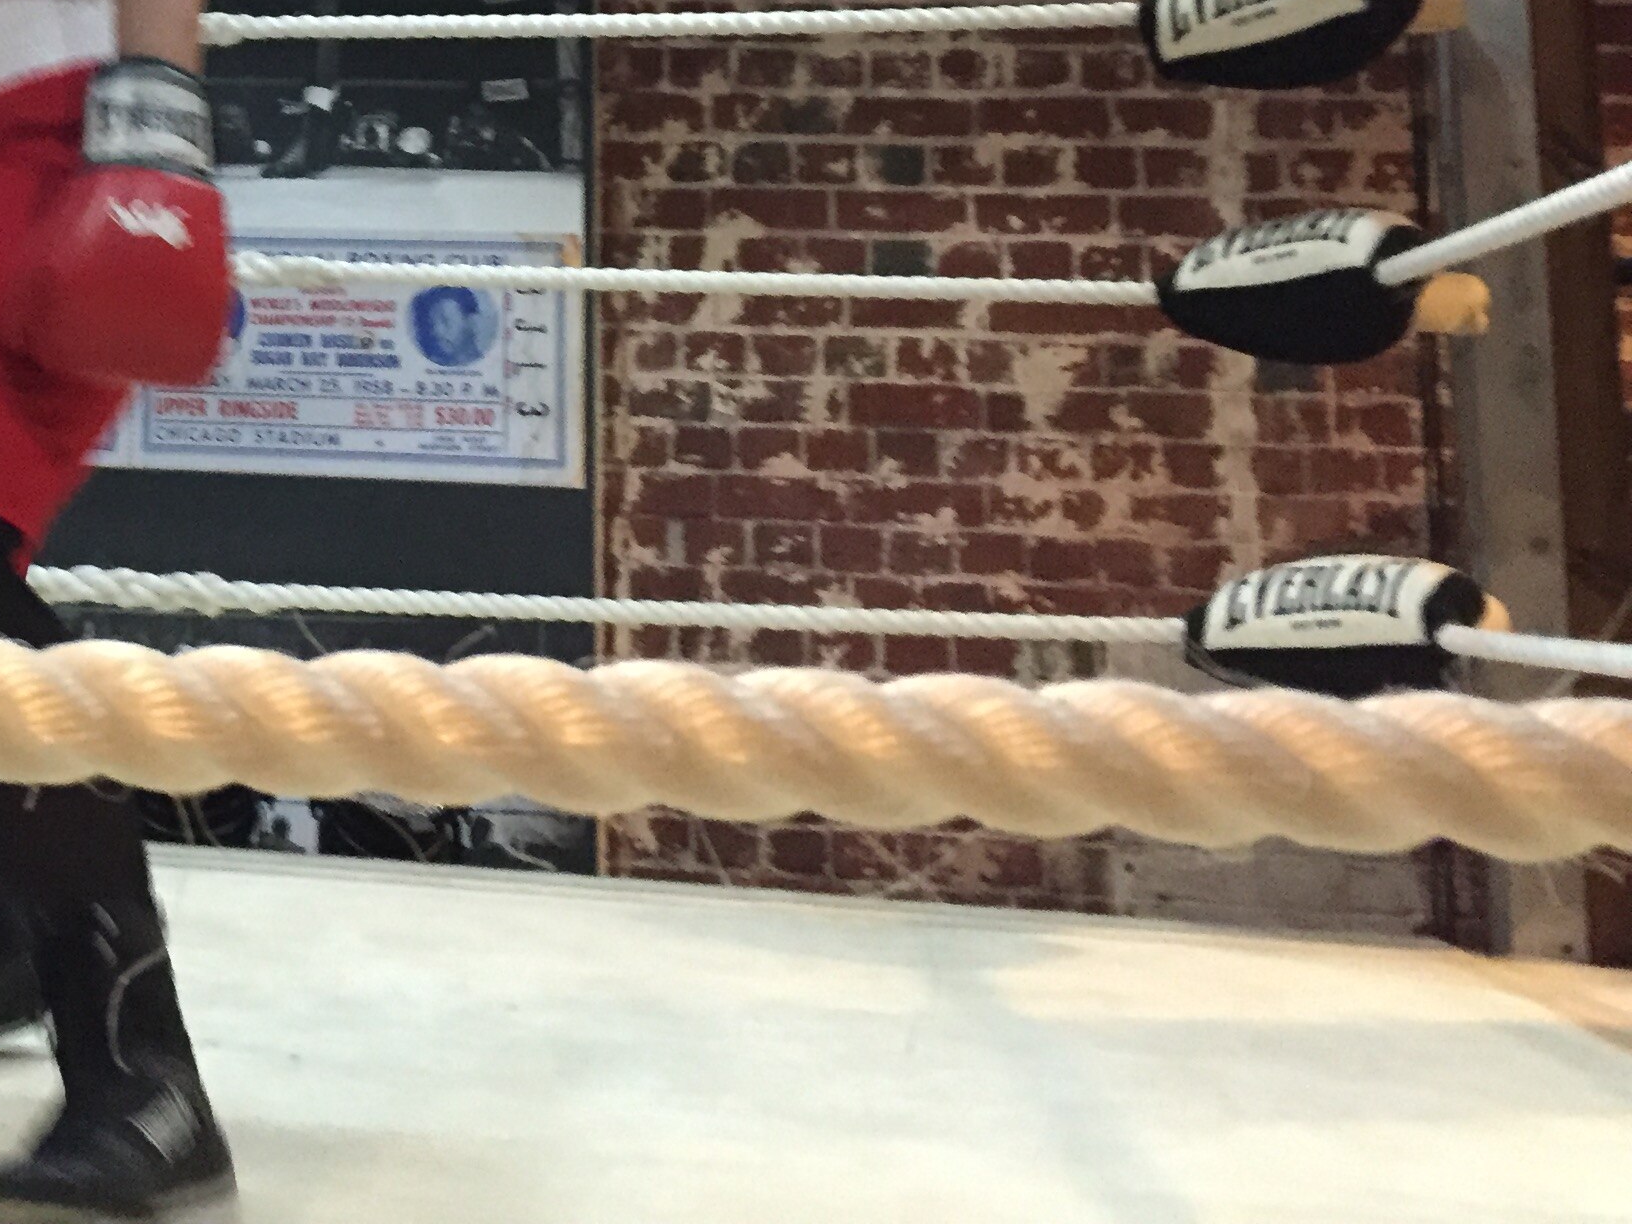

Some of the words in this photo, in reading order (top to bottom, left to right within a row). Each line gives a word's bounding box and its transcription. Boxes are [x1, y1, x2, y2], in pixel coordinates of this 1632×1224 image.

[246, 377, 313, 392] MARCH
[353, 378, 394, 395] 1958
[154, 396, 208, 417] UPPER
[218, 398, 300, 421] RINGSIDE
[154, 425, 242, 443] CHICAGO
[254, 427, 342, 447] STADIUM
[1224, 561, 1413, 633] EVERLAST
